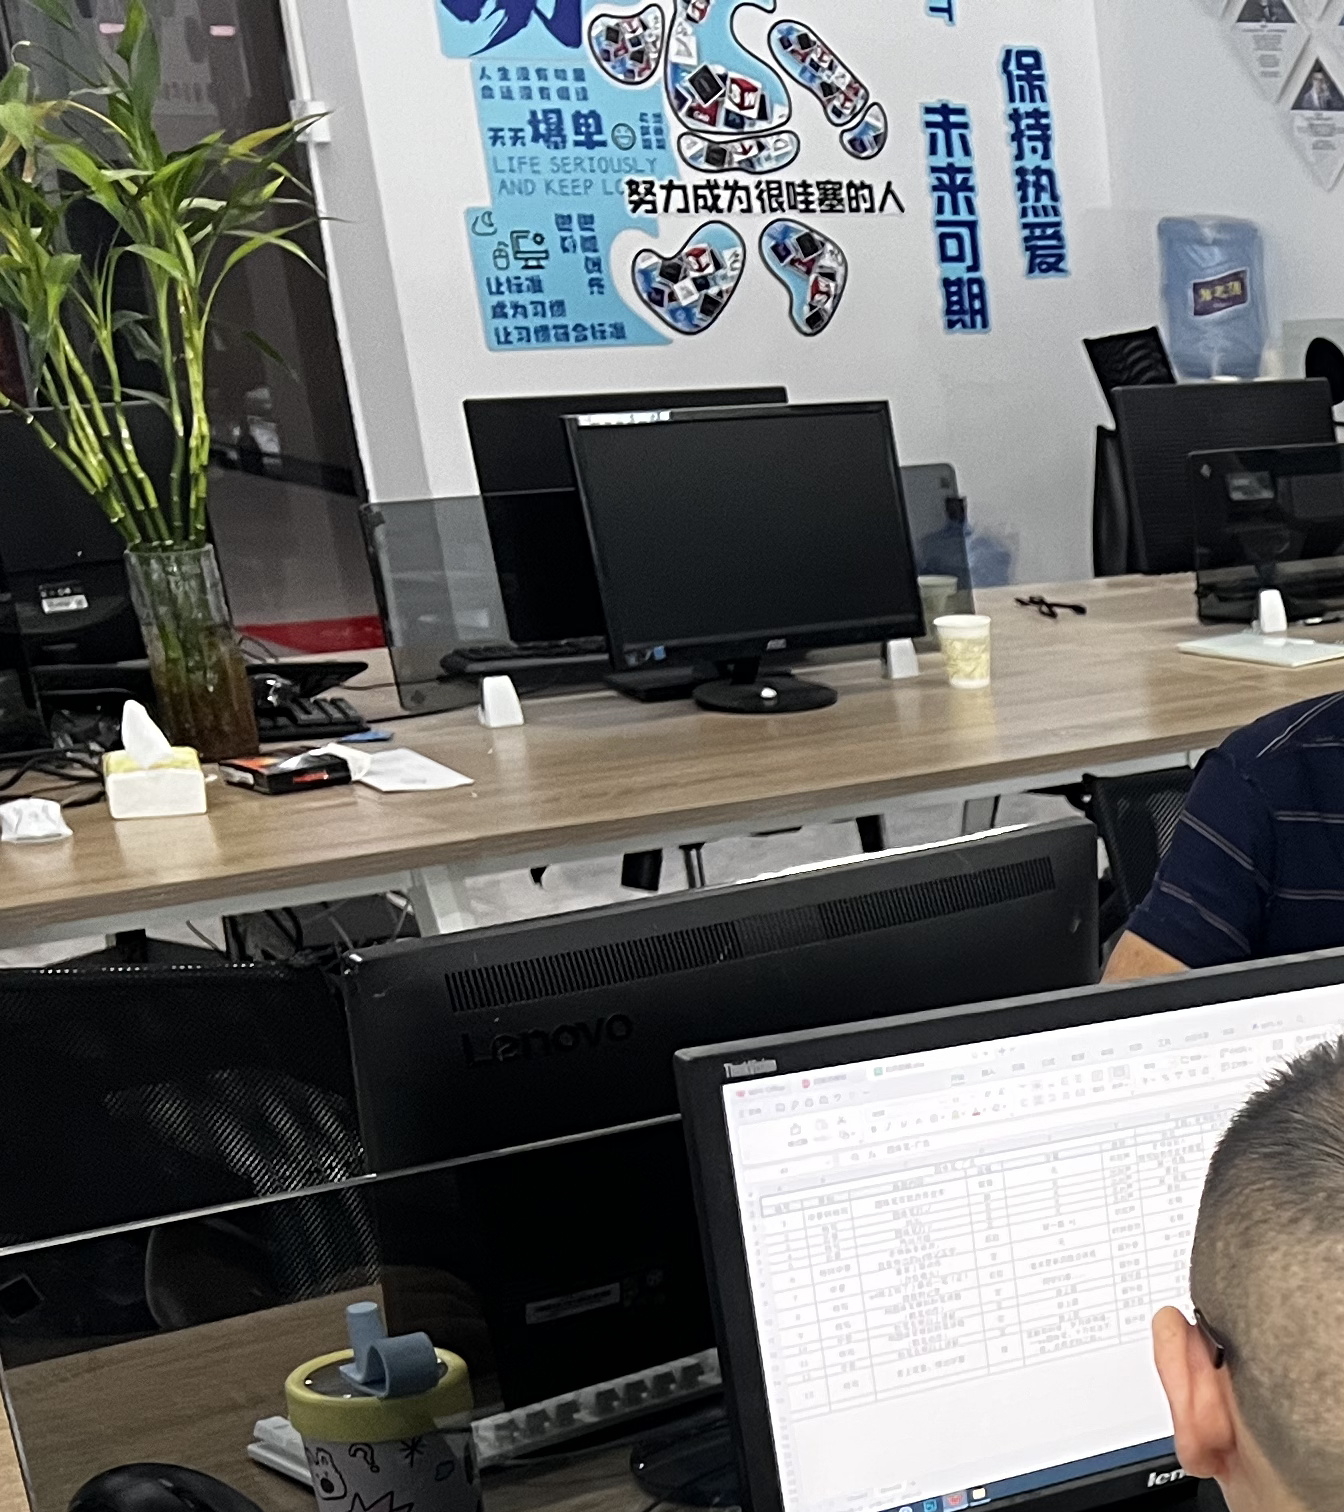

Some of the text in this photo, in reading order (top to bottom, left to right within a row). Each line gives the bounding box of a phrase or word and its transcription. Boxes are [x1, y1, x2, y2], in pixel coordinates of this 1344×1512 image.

[493, 156, 657, 174] LIFE SERIOUSLY
[1002, 48, 1068, 274] 保持热爱
[498, 179, 536, 196] AND
[545, 179, 593, 196] KEEP
[625, 178, 906, 214] 努力成为很哇塞的人
[924, 103, 990, 329] 未来可期
[461, 1013, 633, 1068] Lenovo
[1147, 1468, 1185, 1488] len
